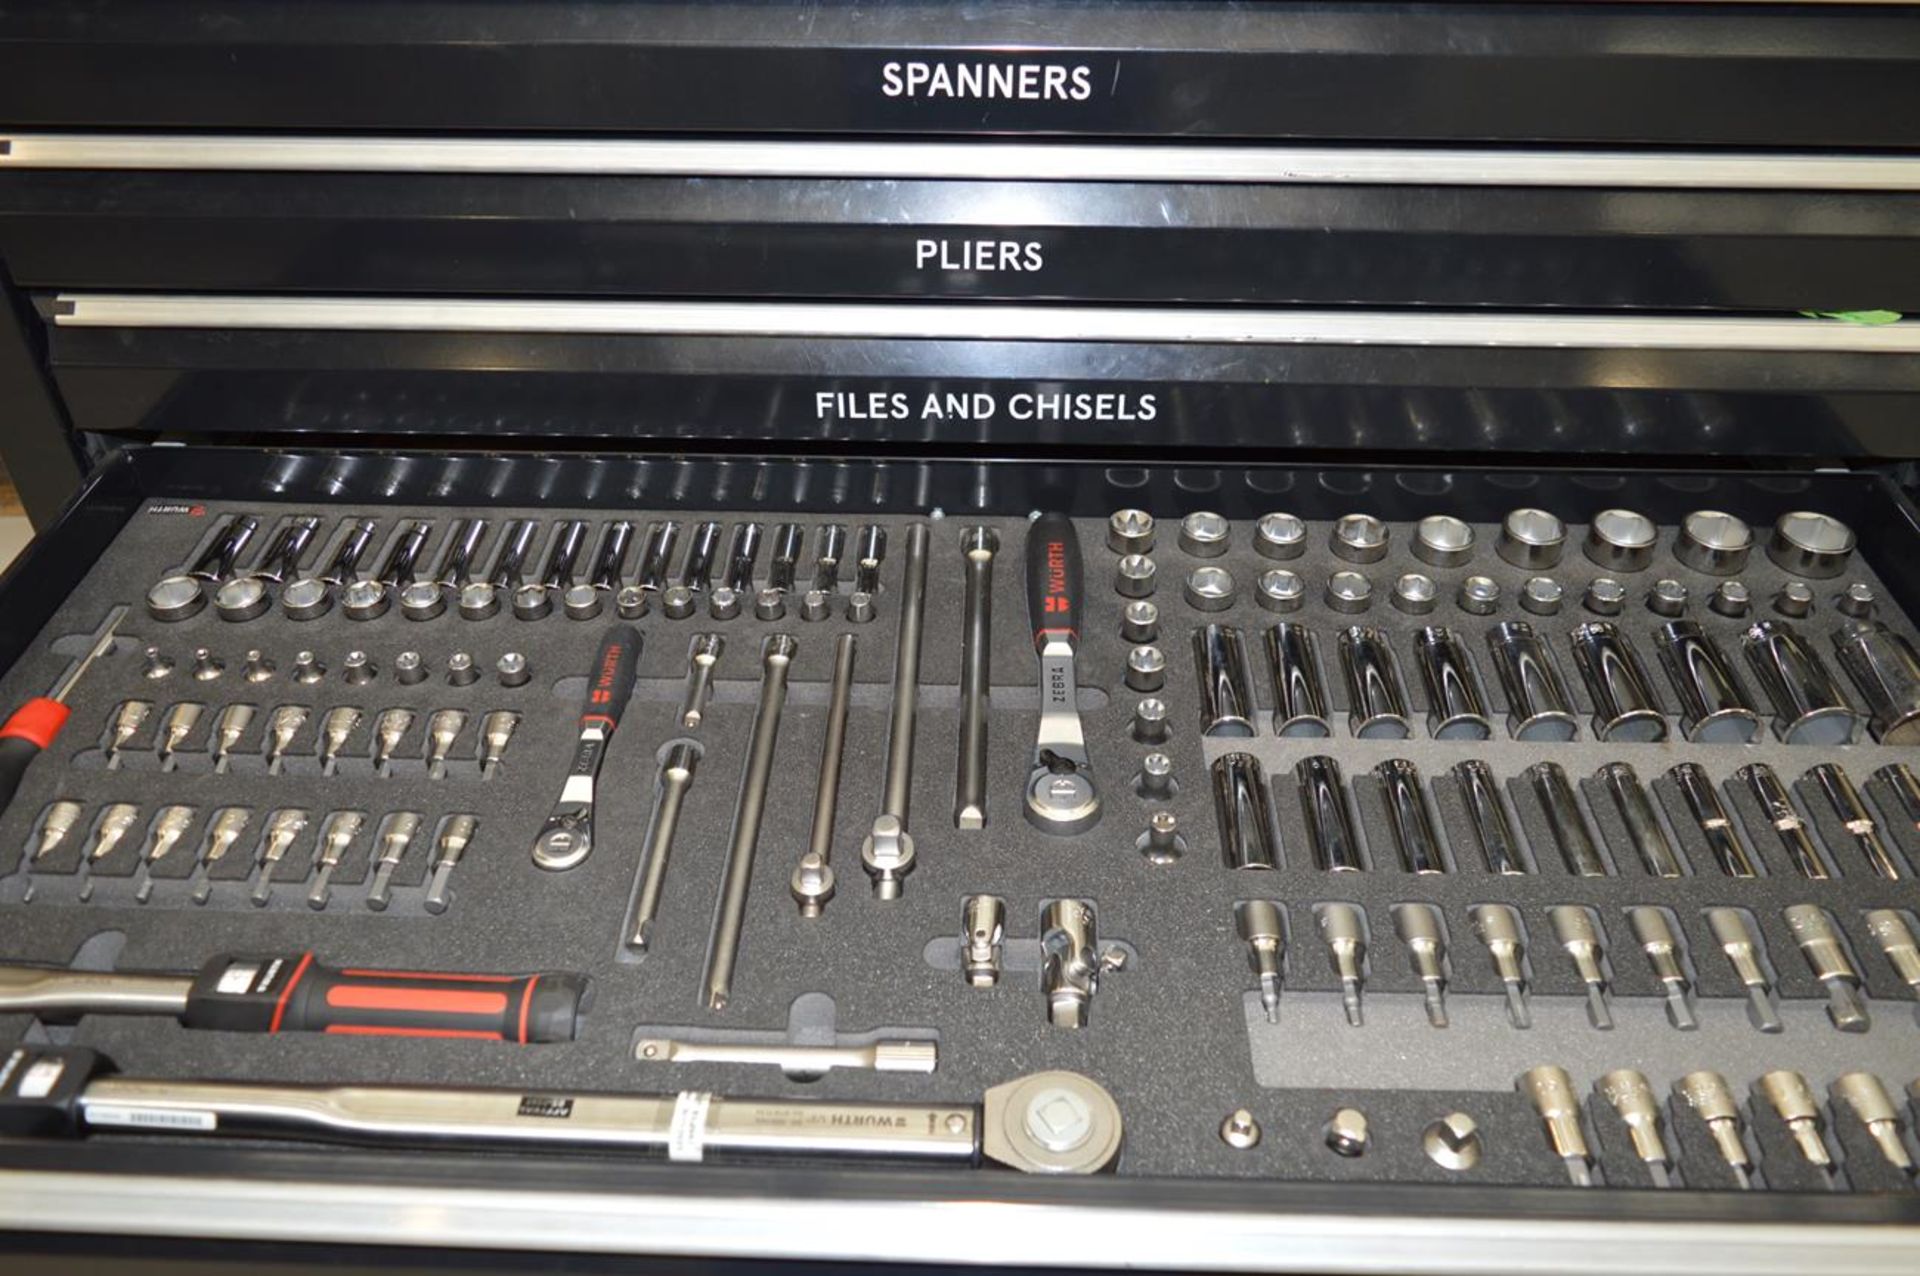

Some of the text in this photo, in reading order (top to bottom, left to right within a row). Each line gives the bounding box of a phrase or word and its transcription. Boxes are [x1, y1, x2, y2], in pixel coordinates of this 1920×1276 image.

[882, 62, 1091, 100] SPANNERS
[916, 239, 1043, 271] PLIERS
[816, 392, 1156, 420] FILES AND CHISELS
[1052, 666, 1066, 702] ZEBRA
